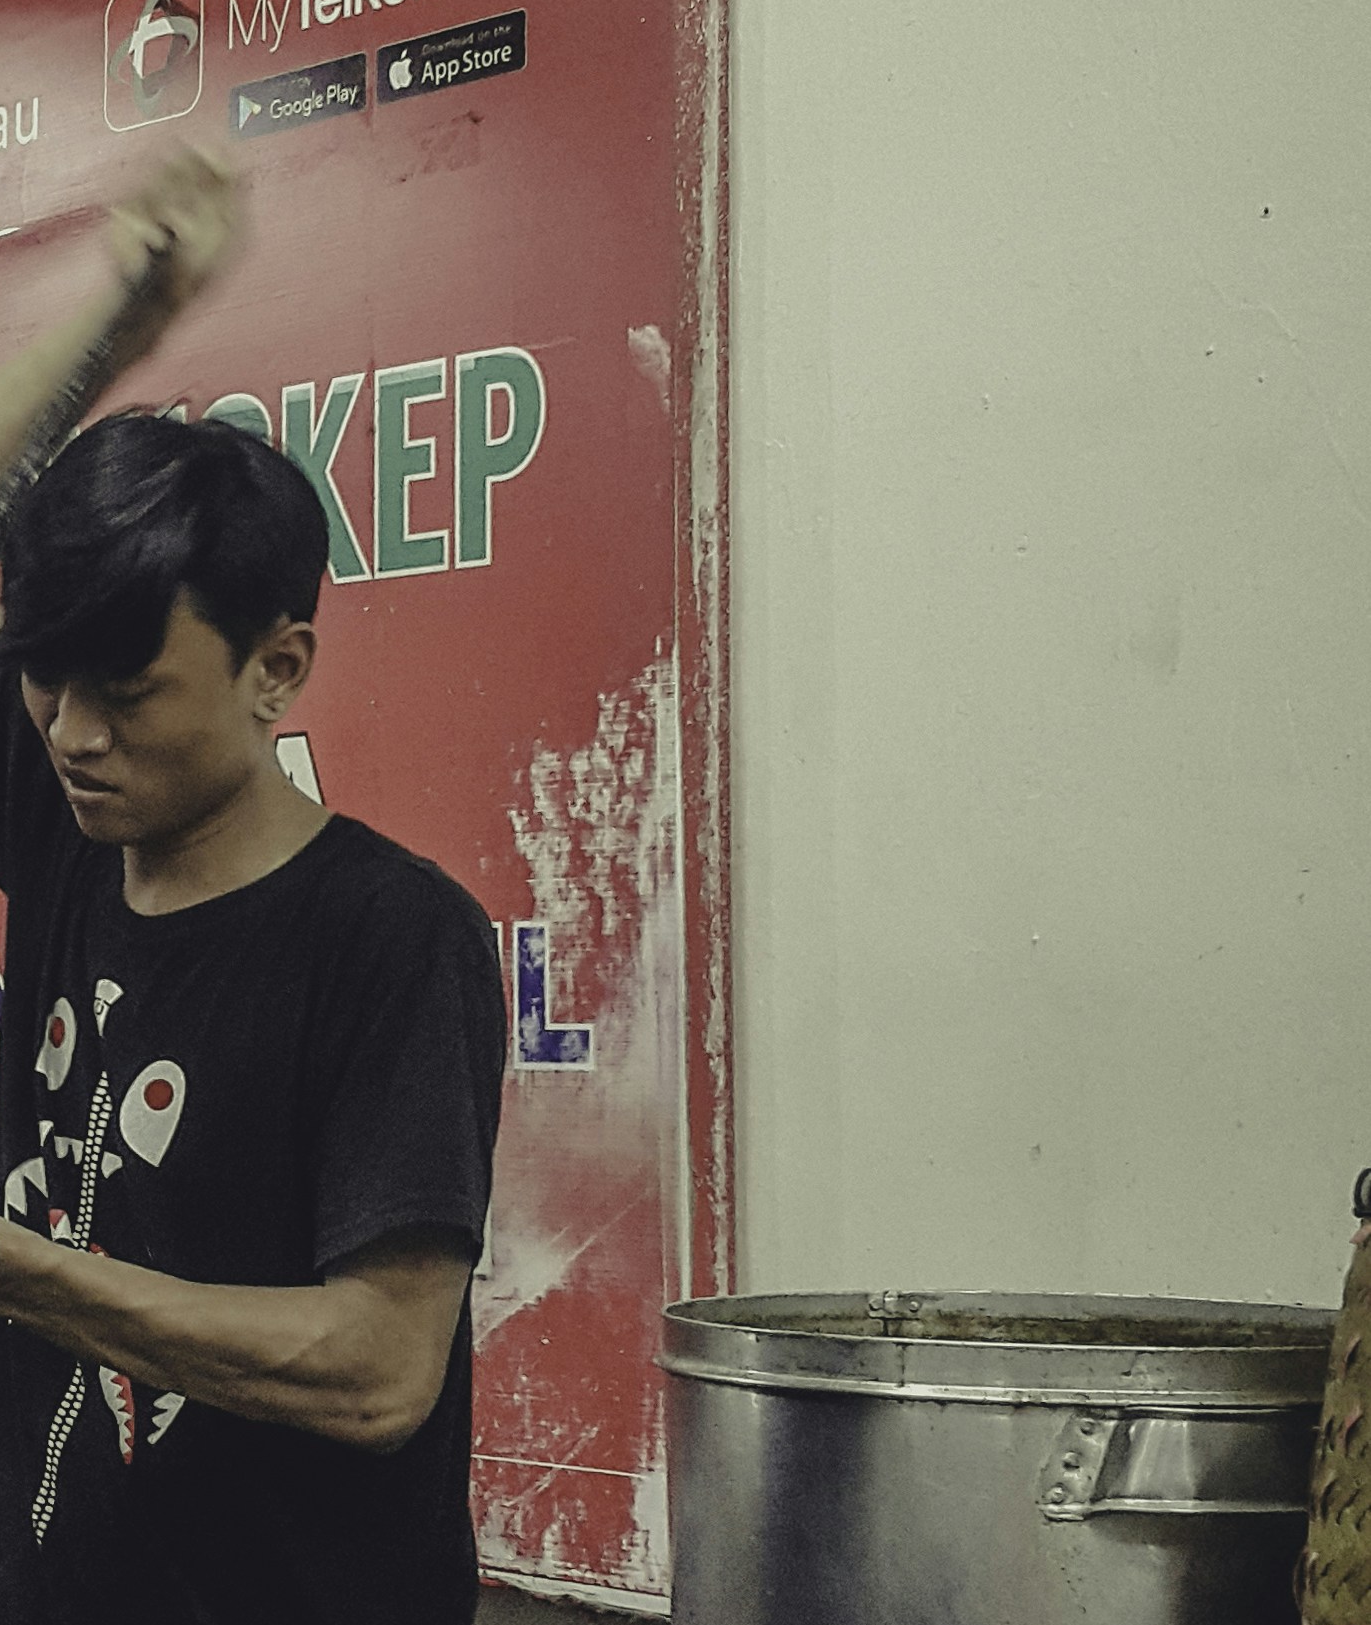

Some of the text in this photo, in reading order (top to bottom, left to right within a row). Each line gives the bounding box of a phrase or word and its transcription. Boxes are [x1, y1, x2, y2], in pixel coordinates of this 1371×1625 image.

[421, 44, 513, 86] App Store
[269, 84, 359, 119] Google Play
